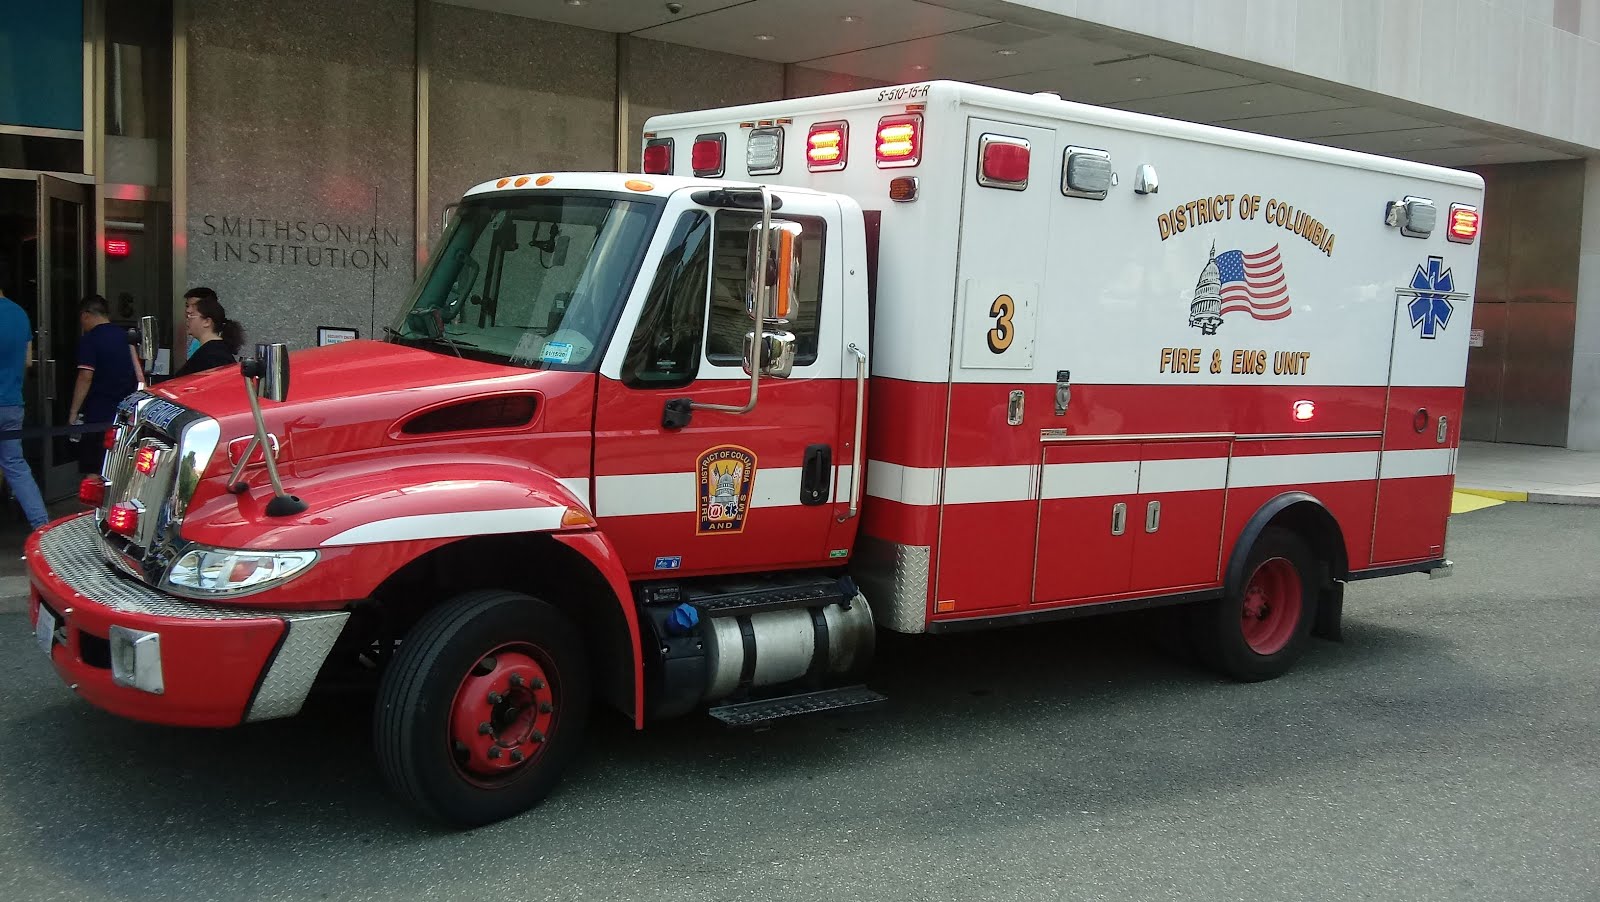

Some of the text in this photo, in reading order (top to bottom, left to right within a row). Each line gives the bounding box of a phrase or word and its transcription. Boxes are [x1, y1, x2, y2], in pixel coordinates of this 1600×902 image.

[877, 84, 931, 102] S-510-15-R
[203, 215, 400, 247] SMITHSONIAN
[1157, 194, 1336, 257] DISTRICT OF COLUMBIA
[213, 241, 390, 270] INSTITUTION
[987, 294, 1015, 354] 3
[1160, 348, 1311, 375] FIRE & EMS UNIT
[701, 451, 752, 485] DISTRICT OF COLUMBIA
[708, 522, 733, 530] AND
[736, 494, 747, 521] EMS
